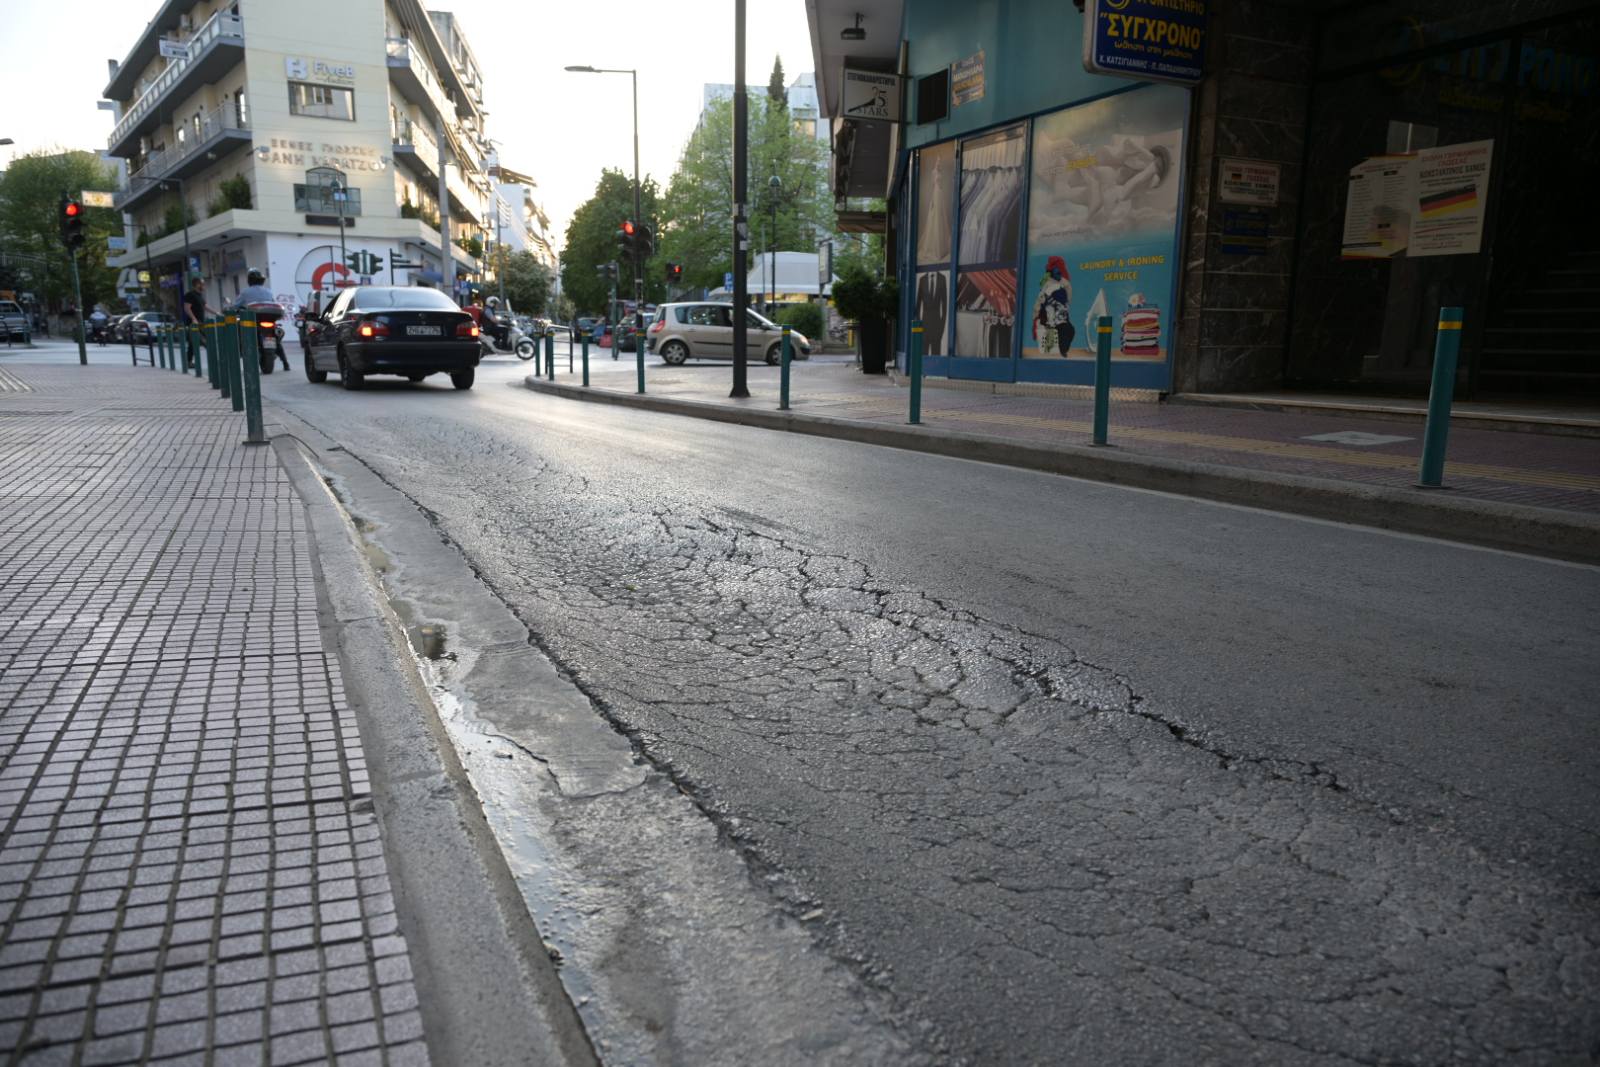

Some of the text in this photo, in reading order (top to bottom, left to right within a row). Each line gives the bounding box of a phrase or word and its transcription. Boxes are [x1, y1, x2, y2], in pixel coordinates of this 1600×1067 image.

[856, 105, 889, 118] STARS
[1081, 258, 1118, 271] LAUNDRY
[1127, 255, 1166, 267] IRONING
[1104, 271, 1137, 282] SERVICE
